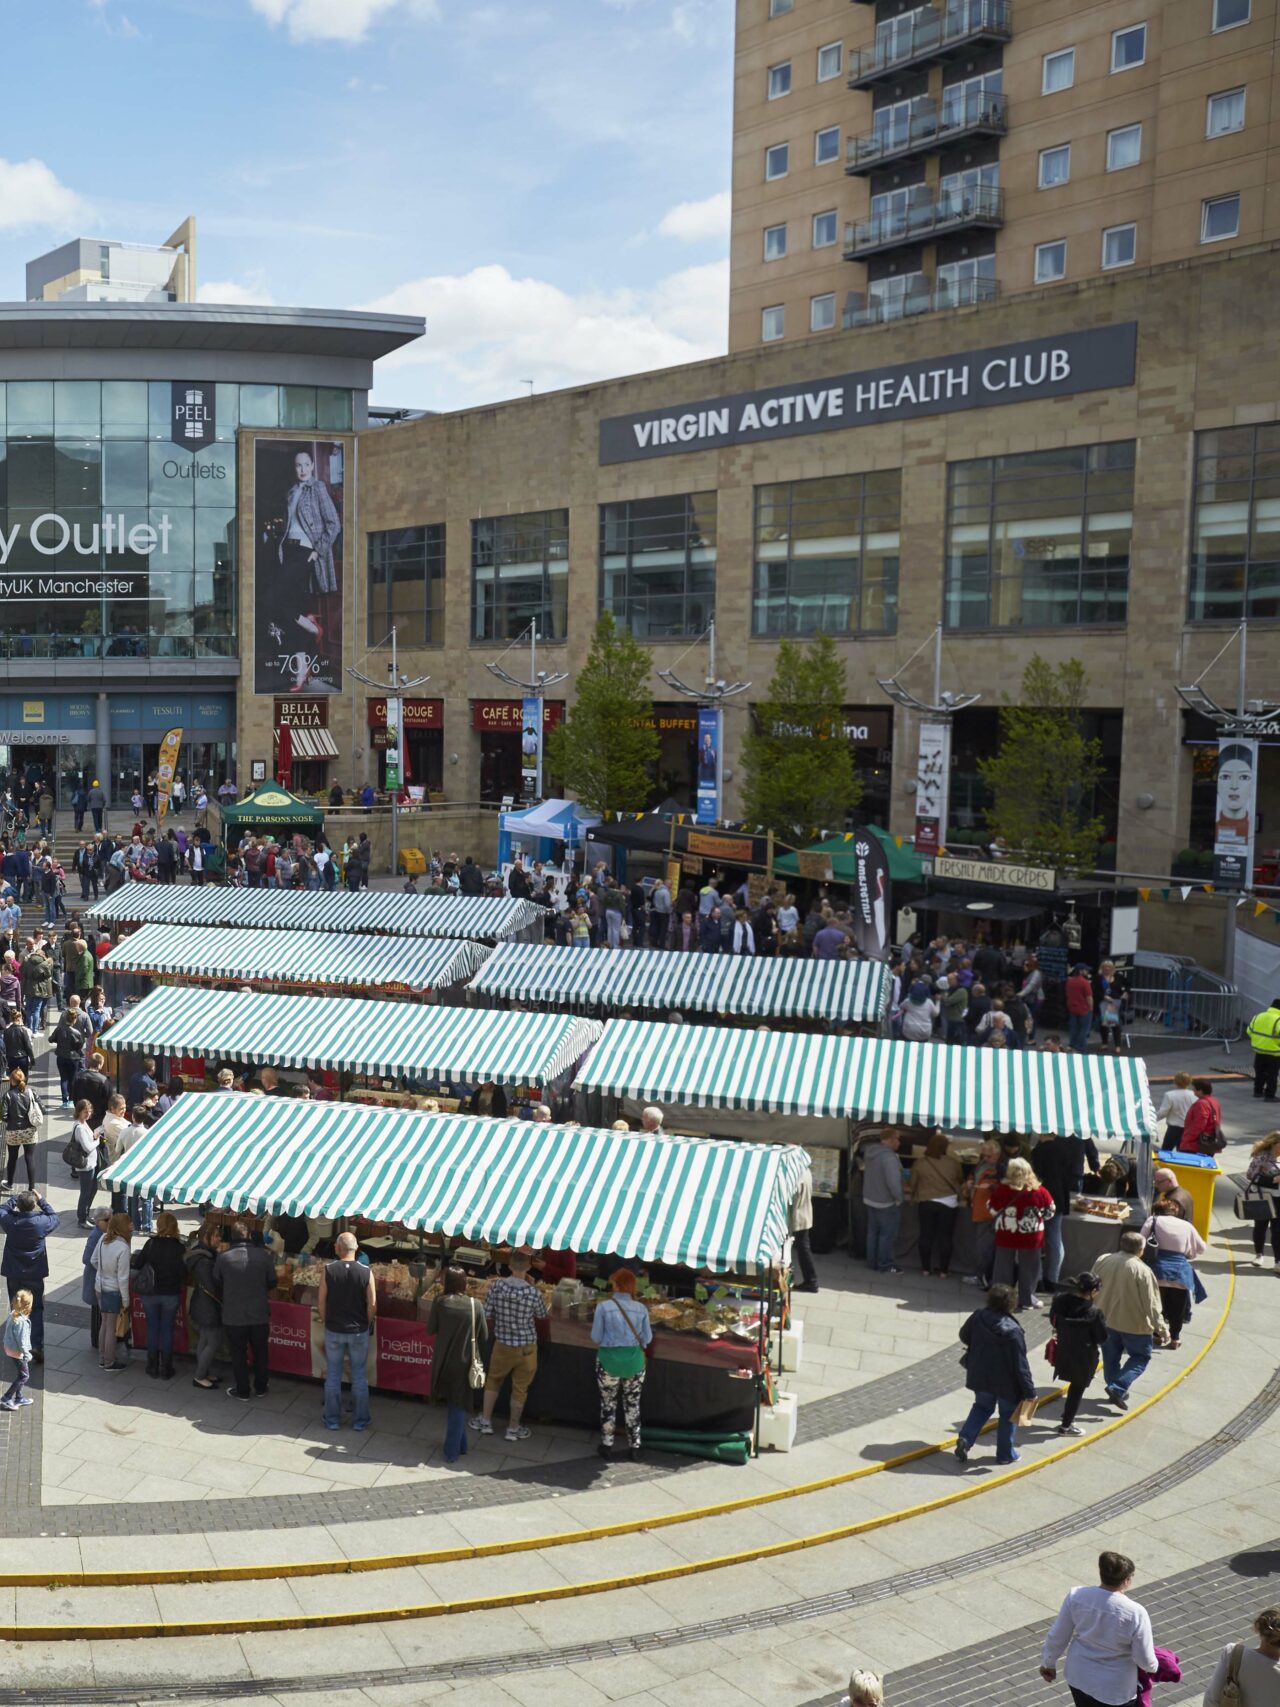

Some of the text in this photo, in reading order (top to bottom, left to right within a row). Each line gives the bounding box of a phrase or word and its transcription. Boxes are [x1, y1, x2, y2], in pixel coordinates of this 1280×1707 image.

[633, 349, 1071, 449] VIRGIN ACTIVE HEALTH CLUB
[175, 405, 212, 421] PEEL
[162, 460, 226, 480] Outlets
[30, 513, 173, 555] Outlet
[38, 578, 135, 595] Manchester
[278, 654, 320, 674] 70%
[152, 706, 183, 716] TESSUTI
[281, 703, 320, 714] BELLA
[403, 705, 433, 718] ROUGE
[482, 705, 509, 720] CAFÉ
[659, 719, 697, 729] BUFFET
[939, 861, 976, 879] FRESHLY
[978, 864, 1007, 883] MADE
[381, 1335, 434, 1354] healthy
[381, 1352, 433, 1366] cranberr
